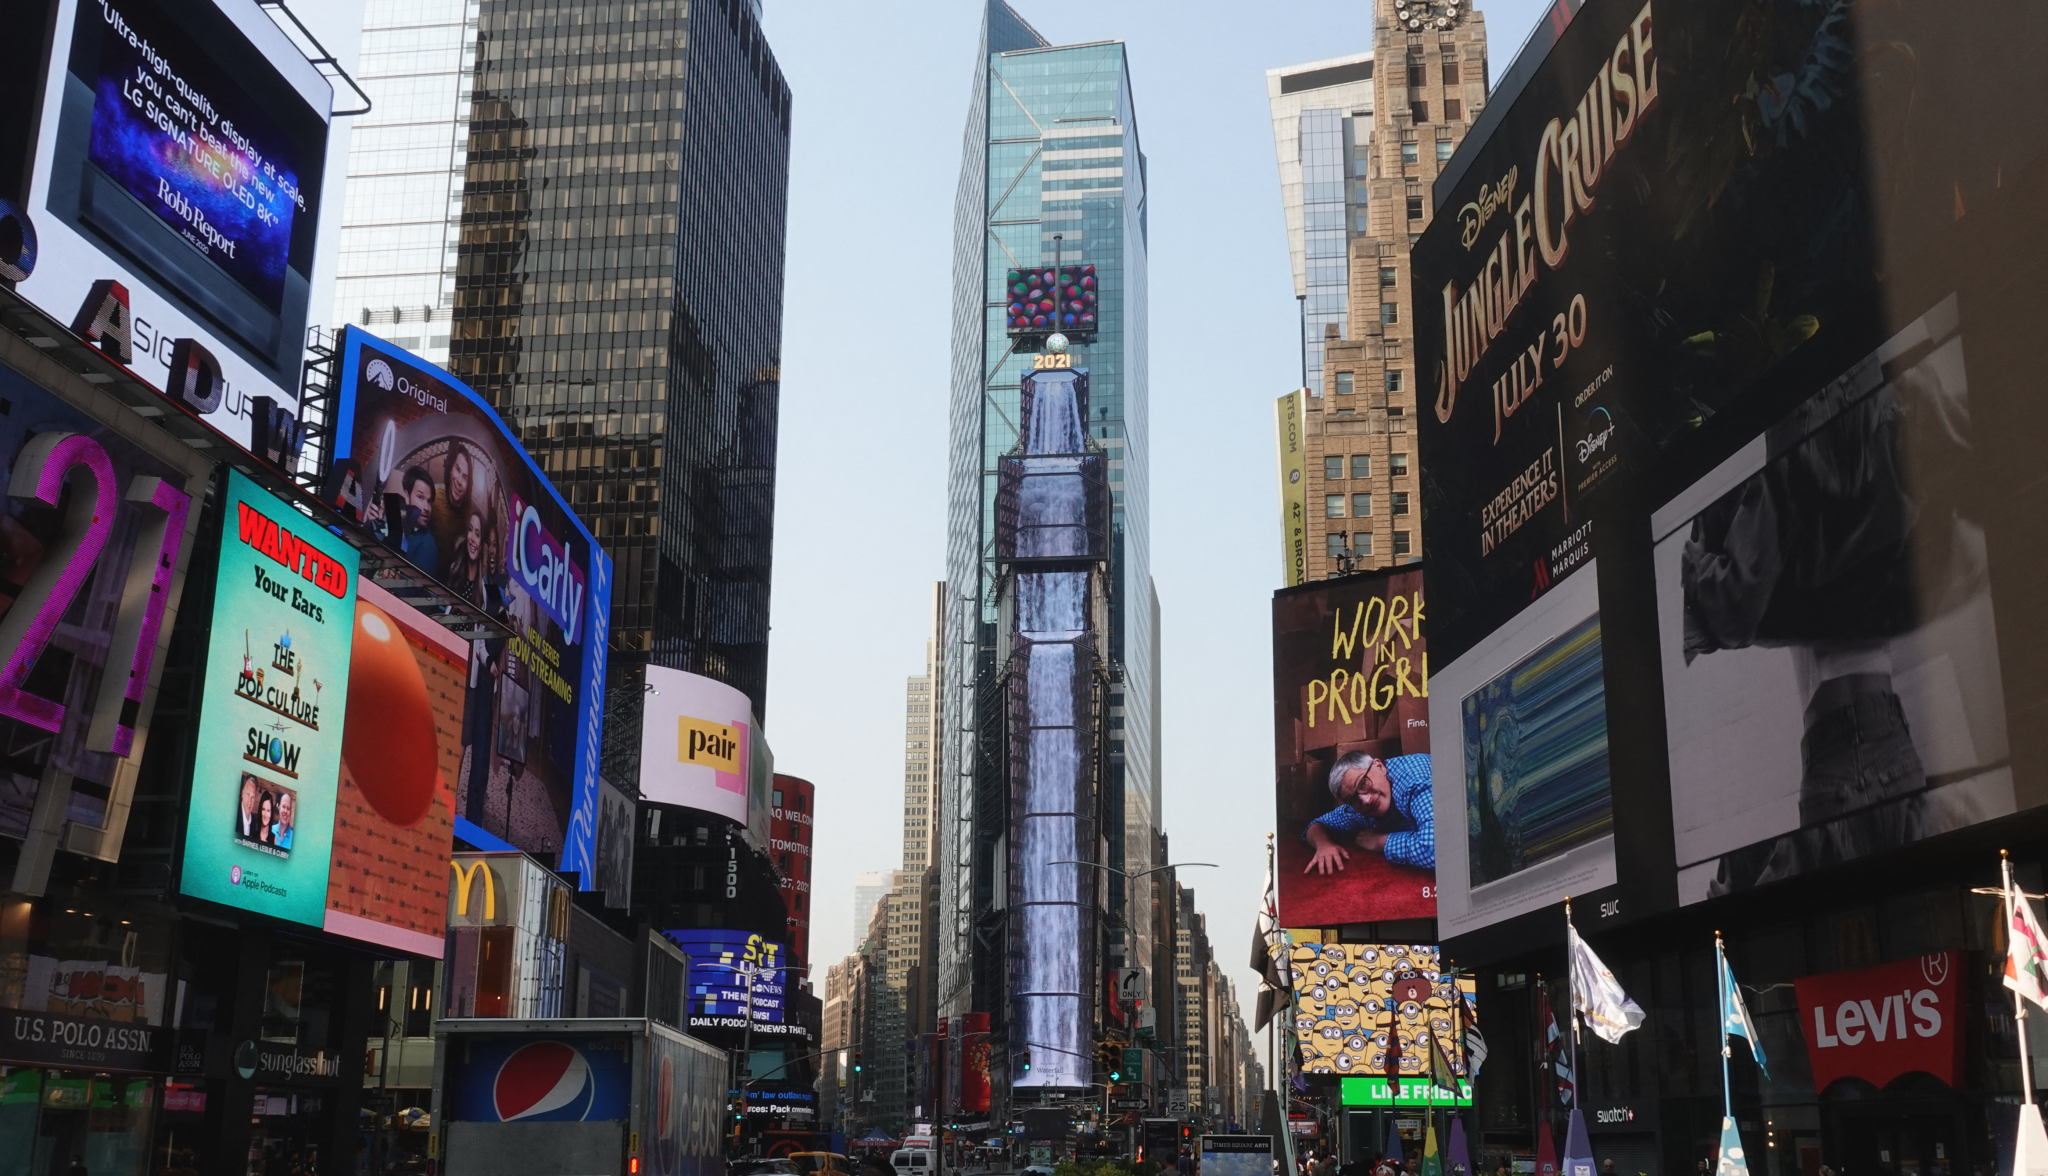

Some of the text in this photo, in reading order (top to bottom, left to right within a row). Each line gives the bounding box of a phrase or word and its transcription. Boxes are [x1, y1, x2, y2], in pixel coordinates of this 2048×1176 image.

[123, 78, 143, 108] LG
[145, 104, 220, 179] SIGNATURE
[222, 172, 255, 210] OLED
[136, 65, 275, 202] you can't beat the new
[221, 120, 262, 167] display
[264, 162, 277, 180] at
[278, 177, 307, 213] scale,
[157, 176, 236, 260] Robb Report
[1435, 0, 1659, 424] JUNGLE CRUISE
[195, 237, 209, 255] 2020
[1034, 354, 1071, 369] 2021
[1492, 293, 1587, 446] JULY 30
[397, 376, 448, 415] Original
[1575, 364, 1613, 409] ORDER IT ON
[1482, 447, 1553, 528] EXPERIENCE IT
[1577, 470, 1598, 492] PREMIER
[1599, 454, 1618, 476] ACCESS
[1481, 471, 1558, 558] IN THEATERS
[237, 500, 348, 599] WANTED
[1552, 519, 1593, 561] MARRIOTT
[513, 500, 582, 646] iCarly
[1552, 542, 1589, 578] MARQUIS
[254, 565, 325, 625] Your Ears.
[274, 643, 295, 671] THE
[527, 626, 560, 668] NEW SERIES
[1374, 641, 1396, 665] IN
[508, 636, 572, 704] NOW STREAMING
[238, 671, 319, 726] POP CULTURE
[1407, 717, 1428, 729] Fine,
[246, 727, 301, 772] SHOW
[689, 728, 736, 761] pair
[242, 876, 287, 897] Apple Podcasts
[725, 847, 738, 898] 1500
[721, 991, 739, 1001] THE
[752, 997, 779, 1008] PODCAST
[763, 985, 782, 995] NEWS
[14, 1016, 153, 1053] U.S. POLO ASSN.
[690, 1017, 719, 1027] DAILY
[753, 1023, 787, 1034] BCNEWS
[61, 1049, 105, 1061] SINCE 1890
[179, 1052, 201, 1060] POLO
[588, 1040, 624, 1051] 85215
[762, 1091, 775, 1099] law
[770, 1104, 790, 1113] Pack
[1171, 1102, 1186, 1111] 25
[1597, 1106, 1628, 1123] swatch
